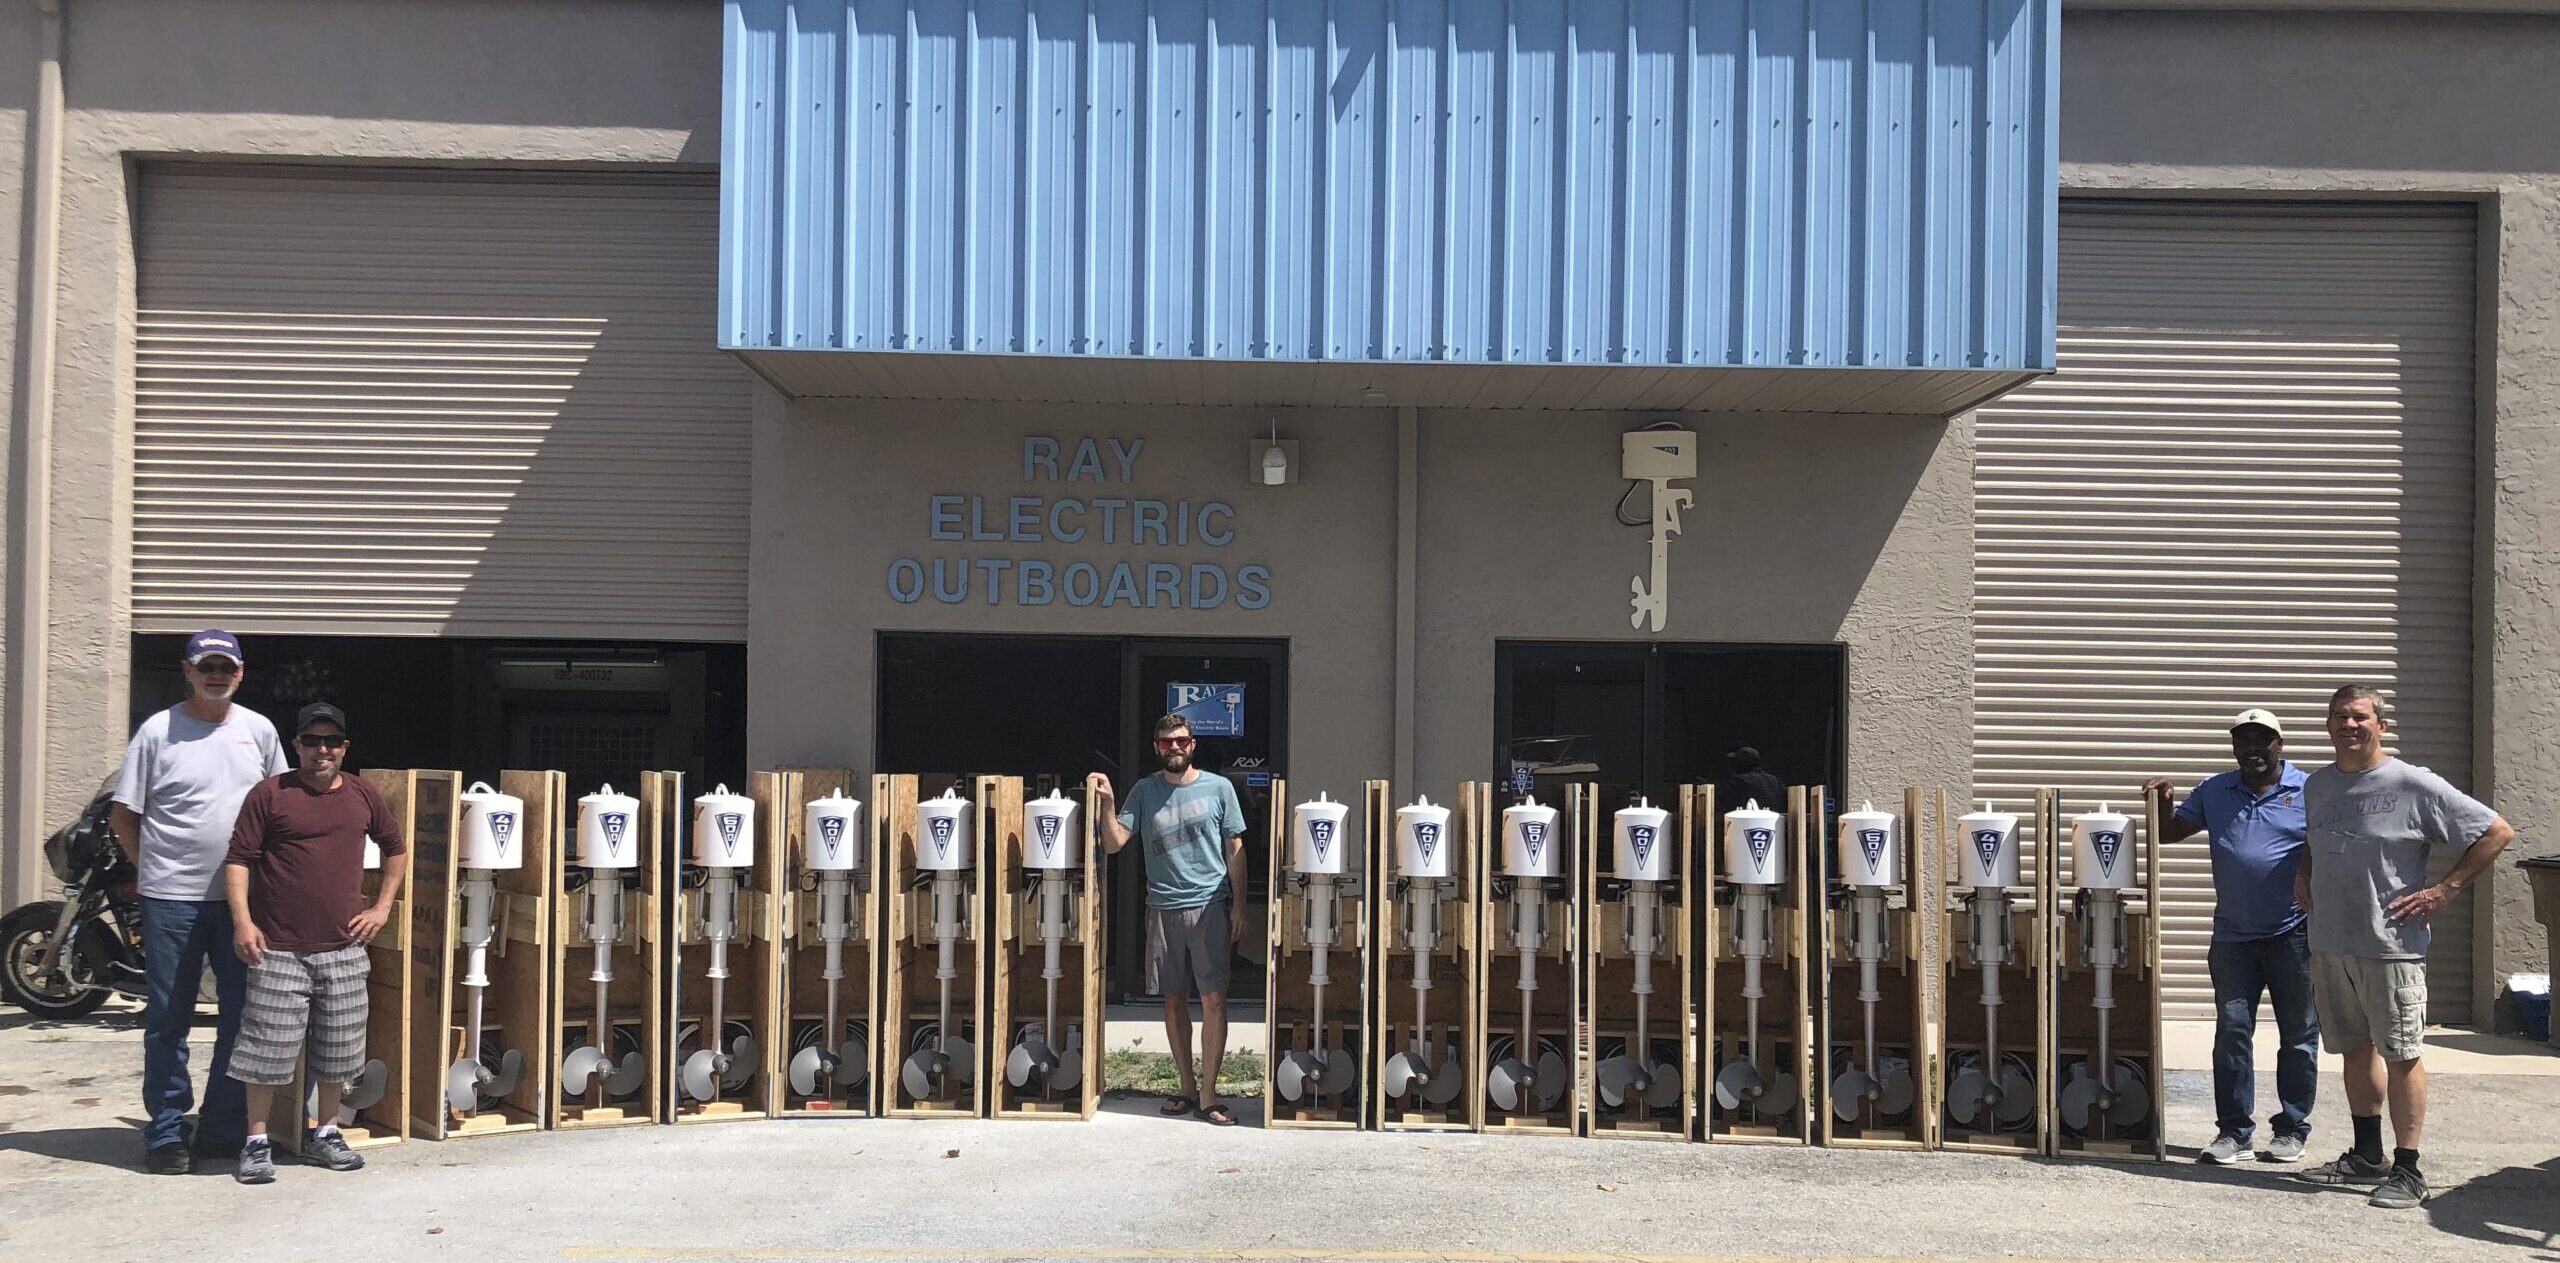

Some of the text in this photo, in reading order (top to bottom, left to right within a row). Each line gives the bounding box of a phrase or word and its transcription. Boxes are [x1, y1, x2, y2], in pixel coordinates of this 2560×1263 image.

[1023, 436, 1144, 484] RAY
[930, 494, 1236, 546] ELECTRIC
[887, 557, 1272, 609] OUTBOARDS
[1171, 685, 1218, 711] RAY
[1232, 756, 1265, 768] RAY
[495, 814, 511, 842] 400
[606, 815, 623, 843] 400
[825, 818, 841, 845] 400
[935, 819, 950, 846] 400
[1315, 822, 1329, 849] 400
[1421, 825, 1436, 851] 400
[1635, 828, 1650, 855] 400
[1752, 831, 1768, 858] 400
[1980, 833, 1996, 860] 400
[2099, 834, 2115, 862] 400
